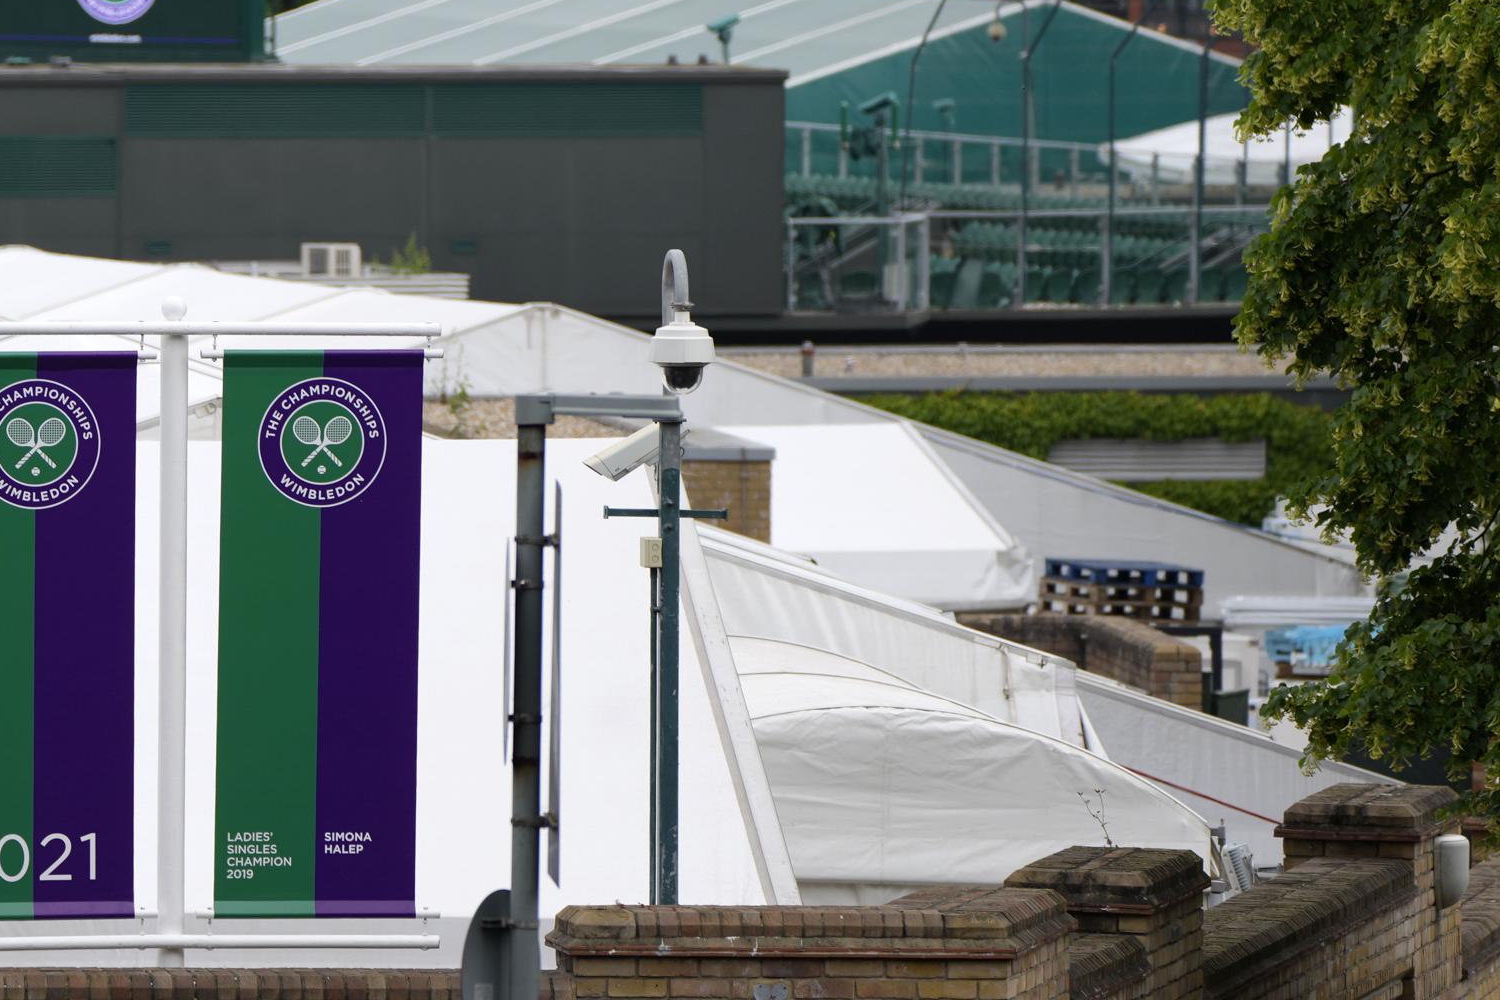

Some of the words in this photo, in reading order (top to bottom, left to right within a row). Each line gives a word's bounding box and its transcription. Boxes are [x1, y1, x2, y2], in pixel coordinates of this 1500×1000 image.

[265, 410, 284, 438] THE
[281, 384, 379, 439] CHAMPIONSHIPS
[280, 473, 365, 501] WIMBLEDON
[324, 832, 372, 842] SIMONA
[227, 844, 278, 854] SINGLES
[324, 844, 364, 855] HALEP
[226, 856, 292, 867] CHAMPION
[226, 869, 254, 879] 2019
